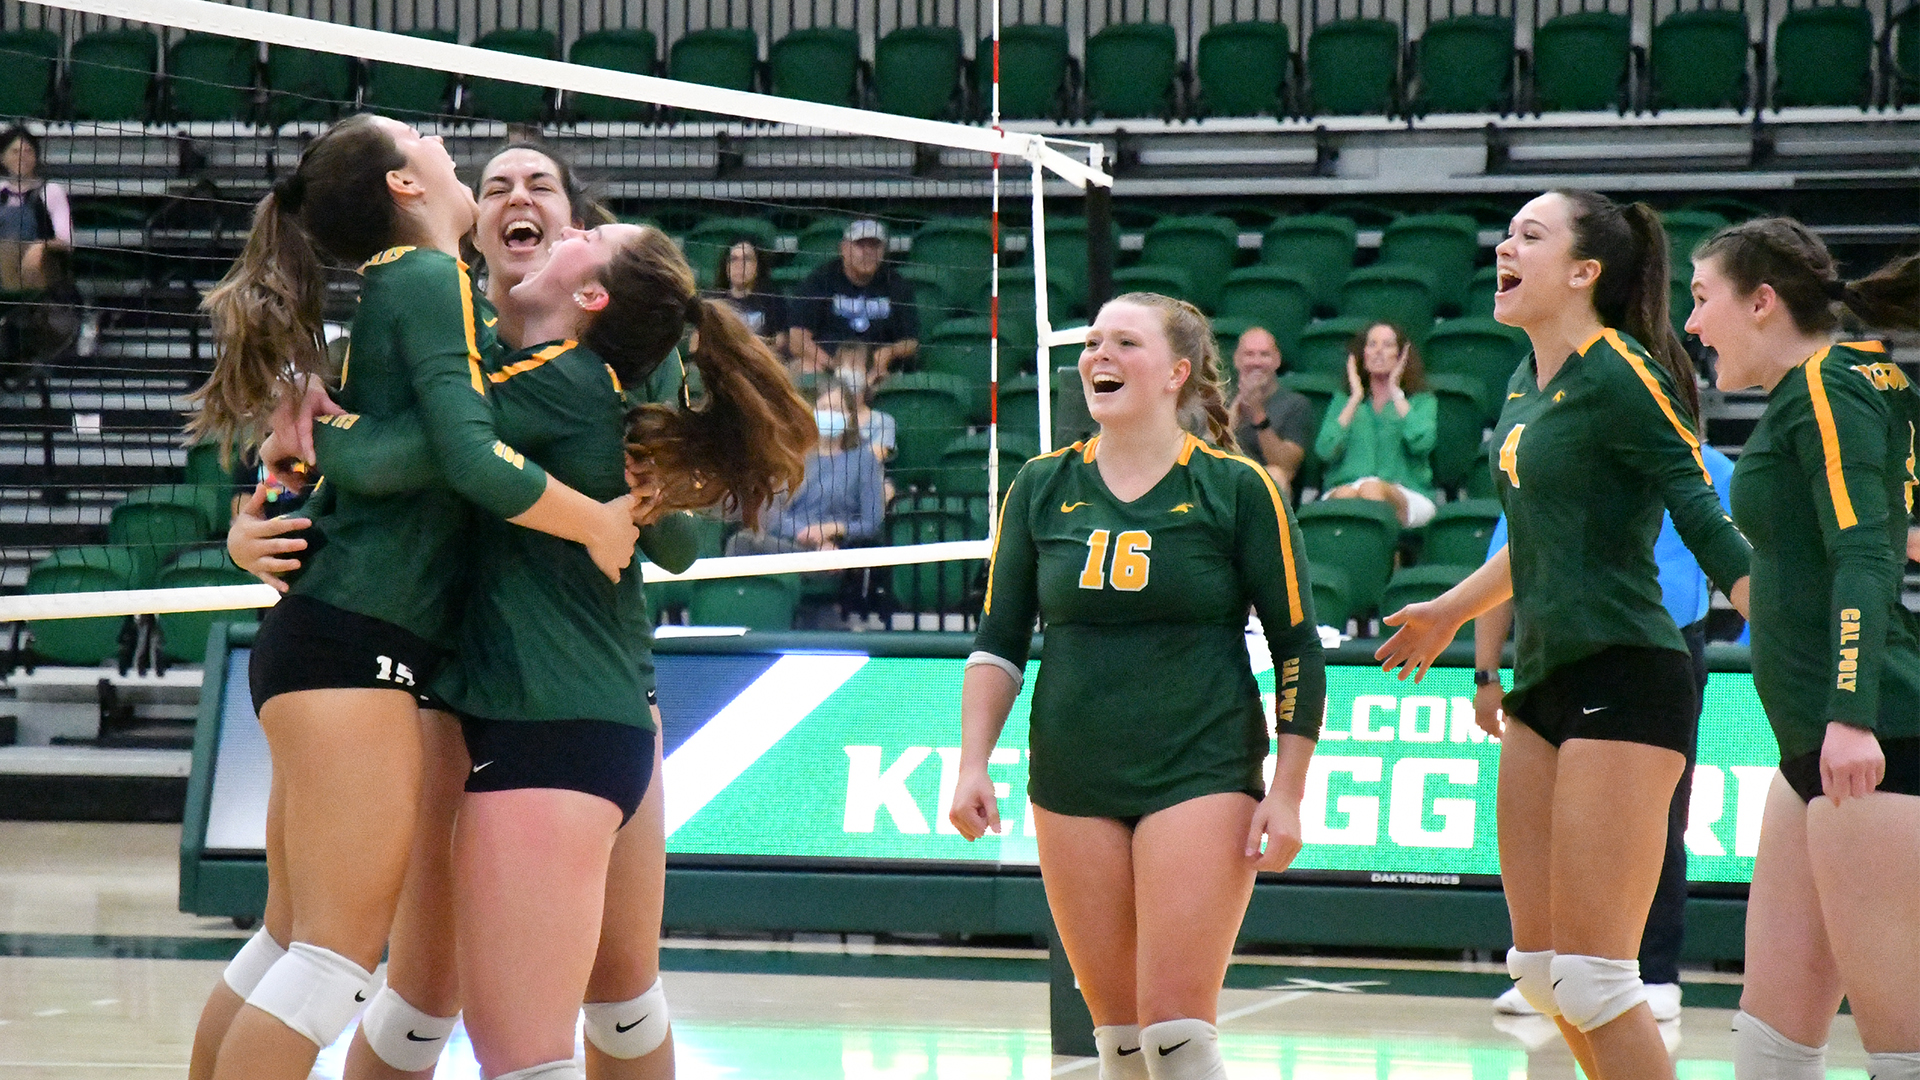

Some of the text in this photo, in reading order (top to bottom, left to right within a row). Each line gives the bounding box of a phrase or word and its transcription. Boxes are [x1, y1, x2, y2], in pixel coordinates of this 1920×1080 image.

[1499, 423, 1526, 489] 4
[1078, 529, 1152, 592] 16
[376, 654, 416, 687] 15
[1836, 608, 1861, 693] CAL POLY
[843, 744, 1038, 837] KE
[1262, 754, 1479, 849] GG
[1370, 872, 1461, 885] DAKTRONICS
